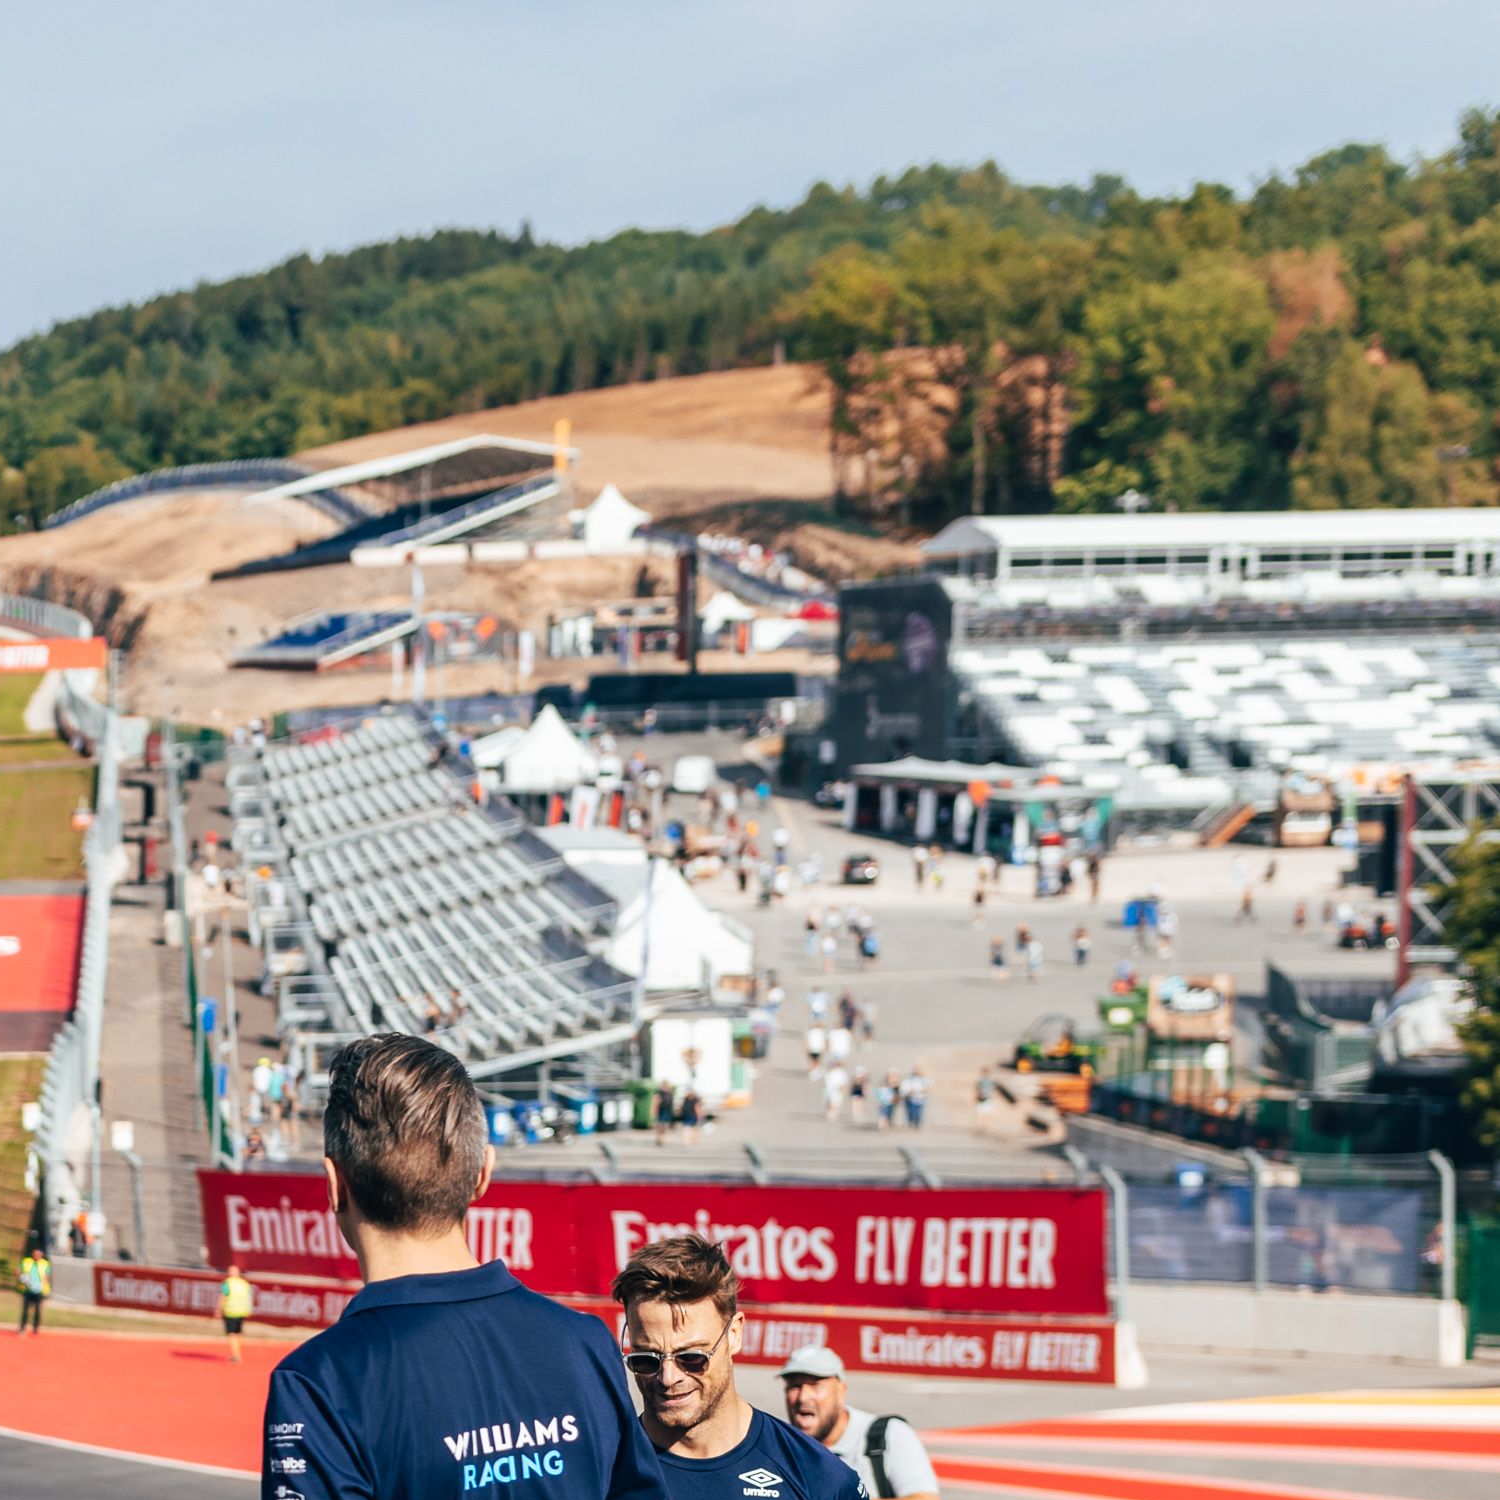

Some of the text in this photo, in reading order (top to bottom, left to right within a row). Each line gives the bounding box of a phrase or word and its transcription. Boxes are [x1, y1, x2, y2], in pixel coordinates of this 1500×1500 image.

[855, 1215, 916, 1286] FLY
[921, 1217, 1058, 1289] BETTER
[860, 1325, 986, 1369] Emirates
[443, 1415, 579, 1461] WILLIAMS
[463, 1450, 564, 1490] RACING
[743, 1487, 780, 1498] umbro
